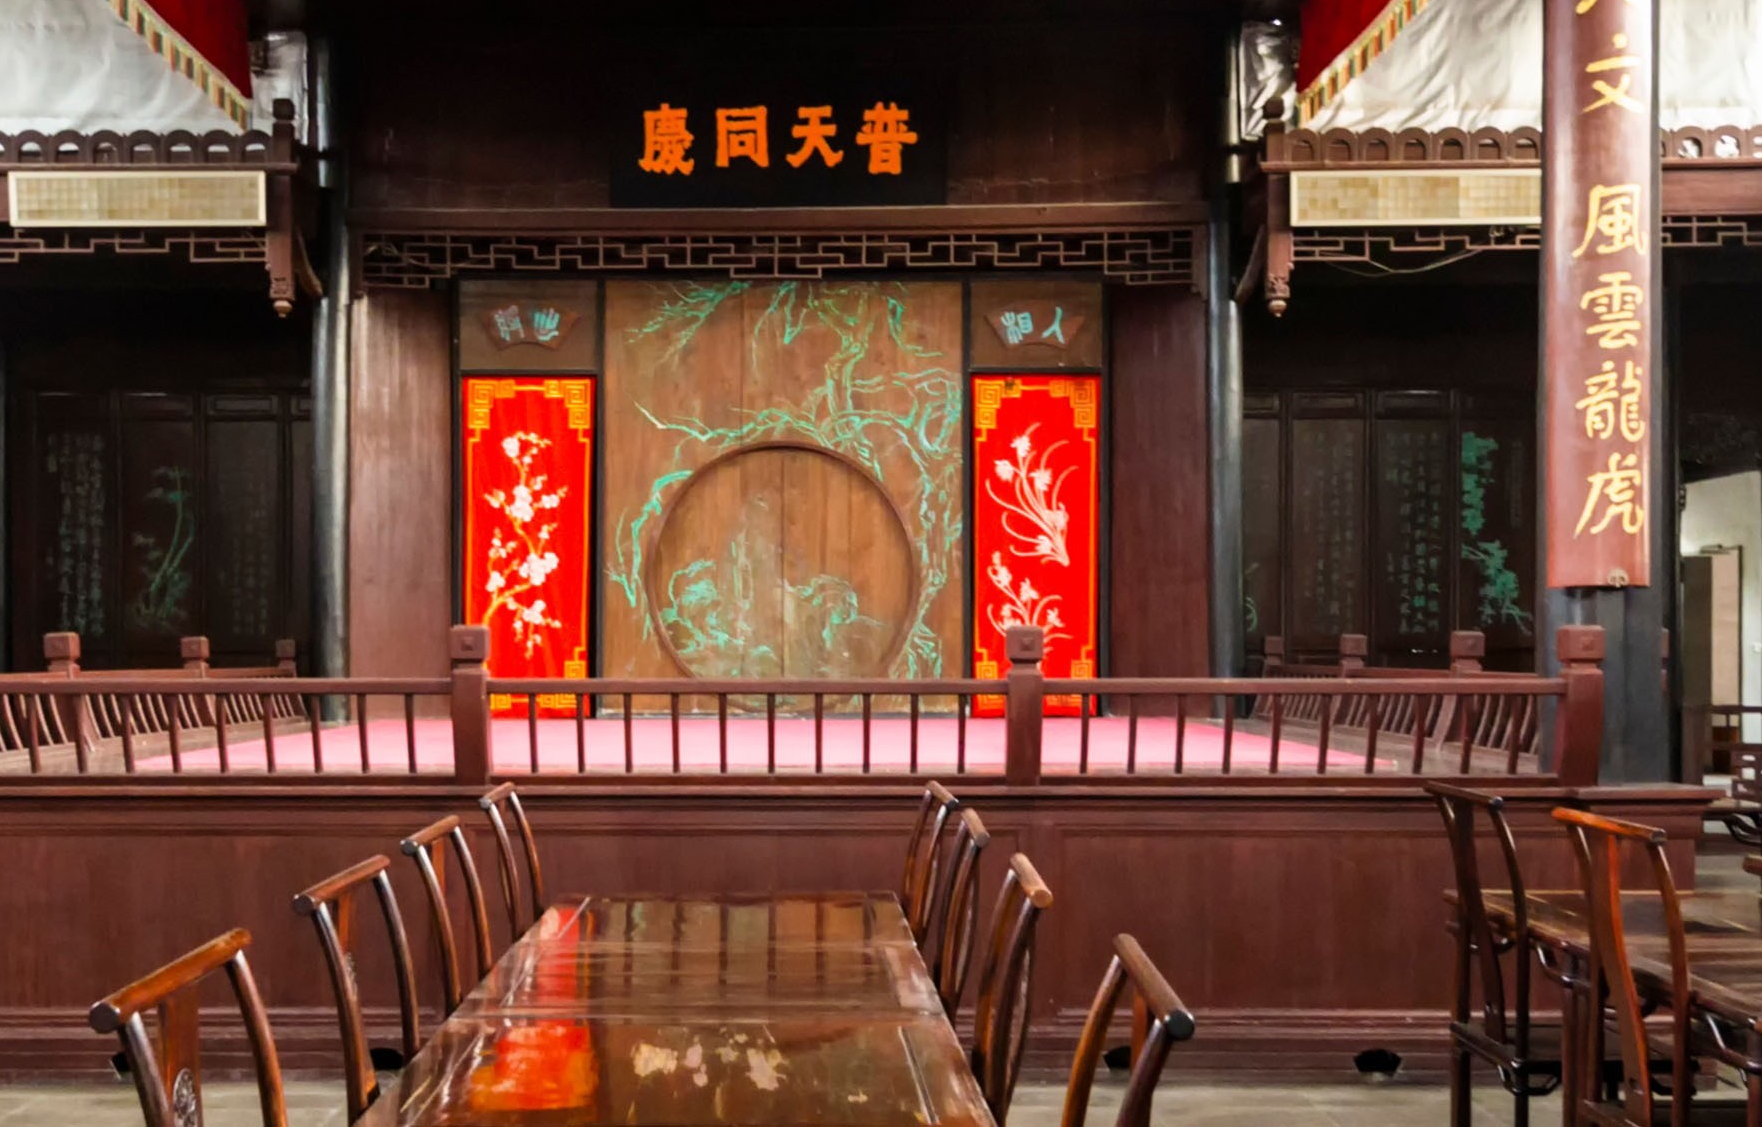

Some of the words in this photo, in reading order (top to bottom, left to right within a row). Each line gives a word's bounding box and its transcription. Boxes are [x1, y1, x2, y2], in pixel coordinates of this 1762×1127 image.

[638, 101, 919, 176] 普天同慶
[1572, 183, 1649, 538] 風雲龍虎
